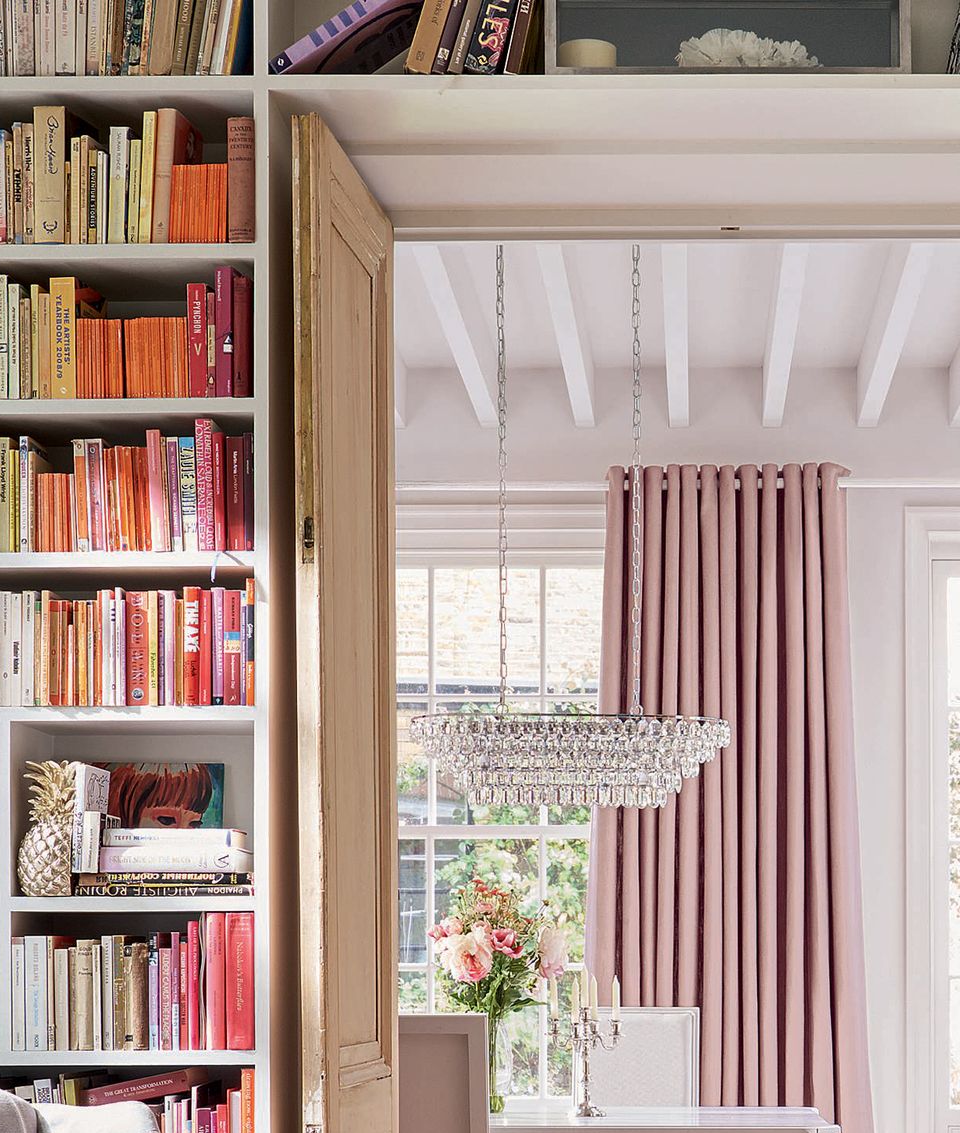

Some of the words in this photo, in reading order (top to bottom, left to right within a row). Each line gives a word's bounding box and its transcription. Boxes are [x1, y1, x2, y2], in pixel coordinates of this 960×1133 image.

[47, 116, 59, 144] Brian
[193, 301, 201, 334] PYNCHON
[195, 421, 204, 466] JONATHAN
[203, 420, 212, 459] EXTREMELY
[180, 447, 195, 479] ZADIE
[181, 484, 195, 516] SMITH
[197, 468, 205, 504] SAFRAN
[206, 526, 214, 549] CLOSE
[184, 600, 199, 625] THE
[133, 886, 198, 896] AUGUSTE
[208, 886, 243, 894] PHAIDON
[130, 1079, 173, 1091] TRANSFORMATION
